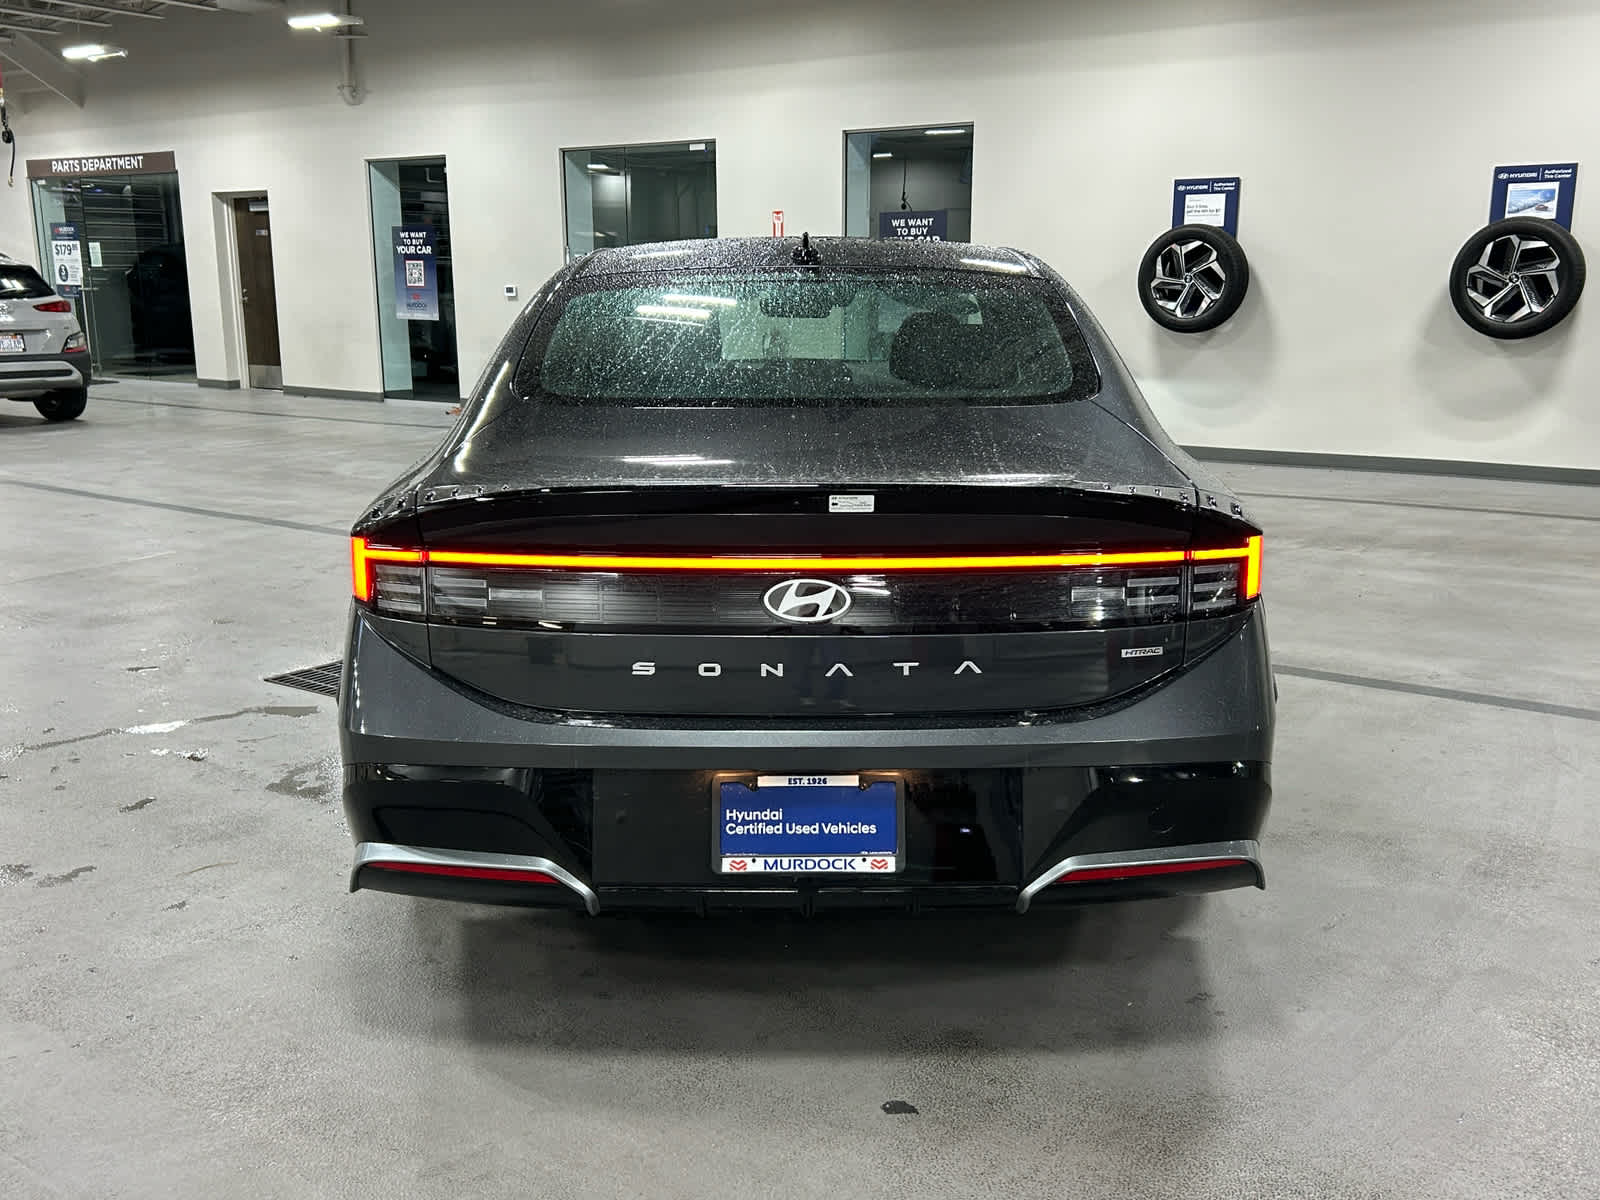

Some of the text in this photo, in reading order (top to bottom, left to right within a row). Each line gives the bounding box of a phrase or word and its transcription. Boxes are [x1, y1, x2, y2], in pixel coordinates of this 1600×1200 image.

[52, 156, 143, 172] PARTS DEPARTMENT
[908, 218, 934, 226] WANT
[897, 227, 928, 236] TO BUY
[396, 246, 432, 254] YOUR CAR
[1125, 648, 1160, 656] HTRAC
[631, 660, 982, 677] SONATA
[788, 777, 828, 785] EST. 1926
[725, 808, 783, 823] Hyundai
[725, 822, 877, 835] Certified Used Vehicles
[763, 859, 856, 870] MURDOCK
